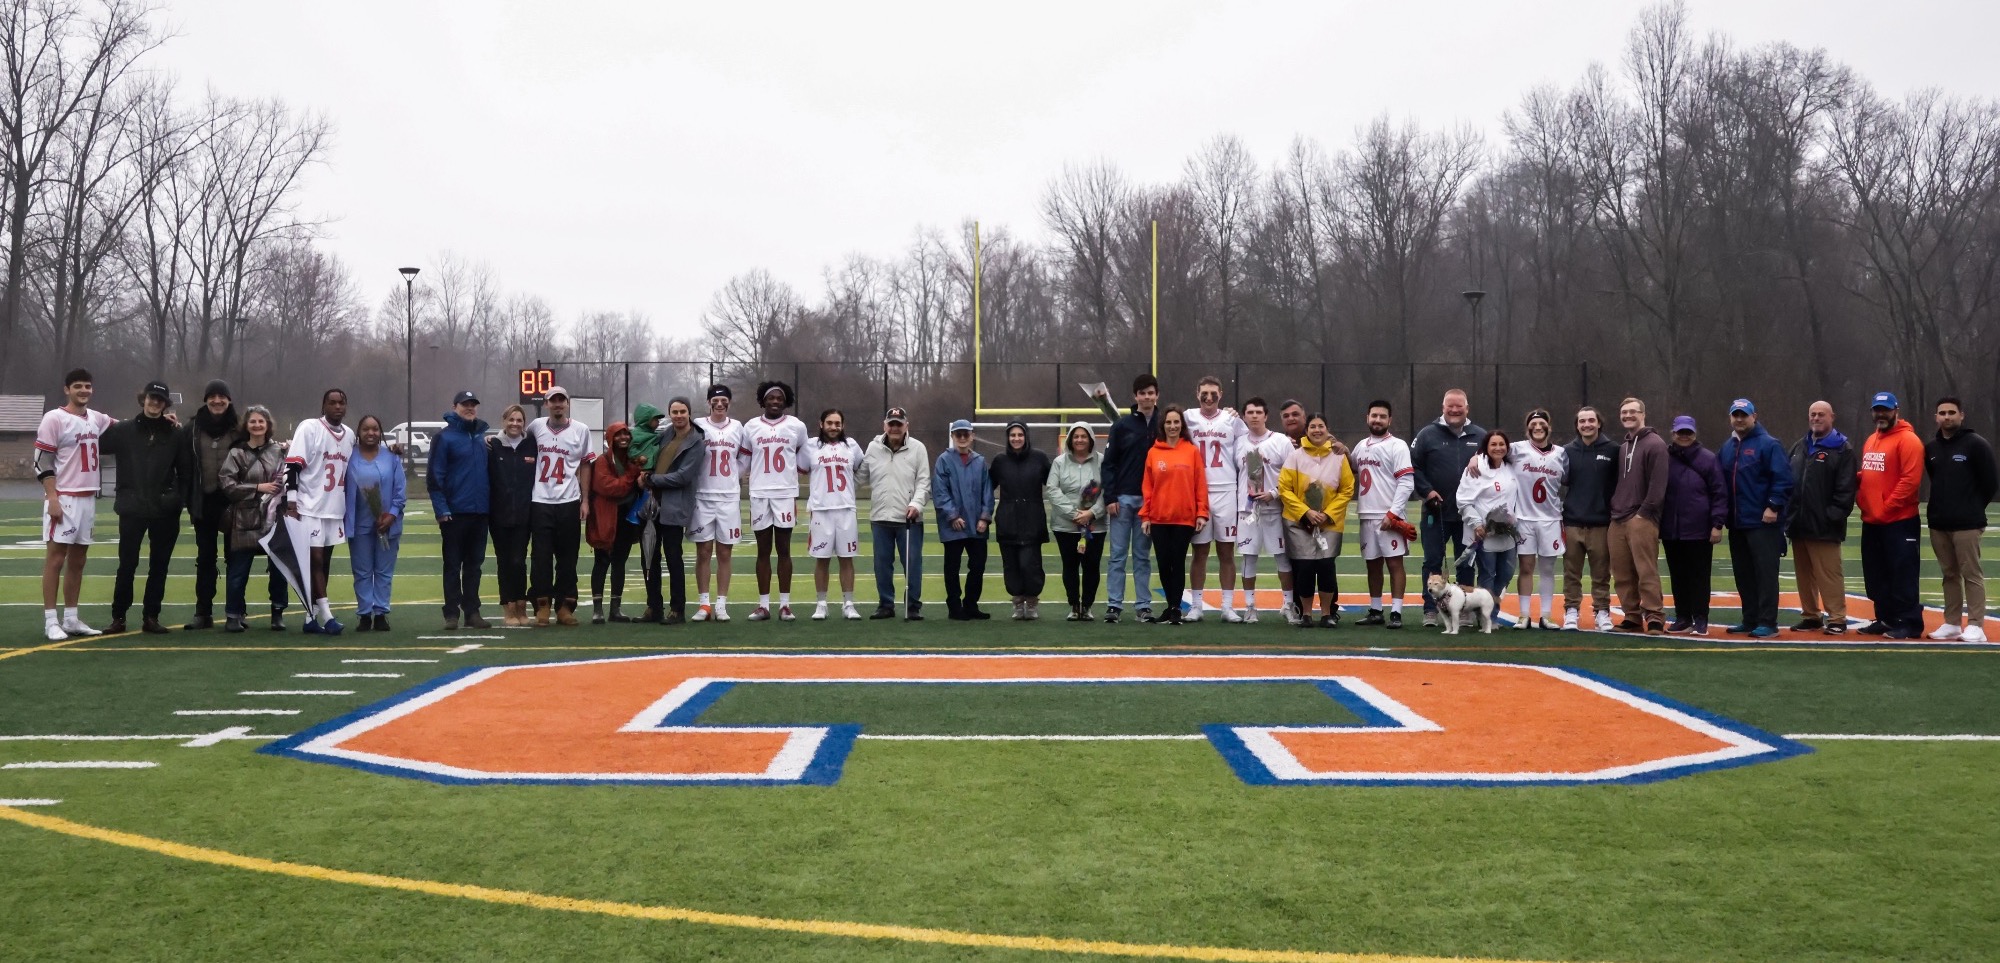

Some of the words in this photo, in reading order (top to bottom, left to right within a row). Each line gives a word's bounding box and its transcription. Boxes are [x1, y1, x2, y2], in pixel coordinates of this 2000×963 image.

[521, 370, 551, 394] 80
[757, 435, 790, 445] Panthers
[1193, 429, 1227, 438] Panthers
[539, 444, 570, 455] Panthers
[1198, 440, 1224, 468] 12
[80, 443, 99, 472] 13
[709, 449, 731, 477] 18
[763, 446, 786, 474] 16
[818, 454, 849, 465] Panthers
[539, 455, 566, 484] 24
[1522, 463, 1558, 476] Panthers
[825, 465, 847, 493] 15
[1360, 468, 1372, 497] 9
[1494, 481, 1501, 492] 6
[1533, 476, 1547, 504] 6
[781, 511, 792, 523] 16
[729, 527, 740, 540] 18
[1225, 526, 1238, 537] 12
[847, 541, 857, 553] 15
[1391, 539, 1398, 551] 9
[1552, 539, 1560, 551] 6
